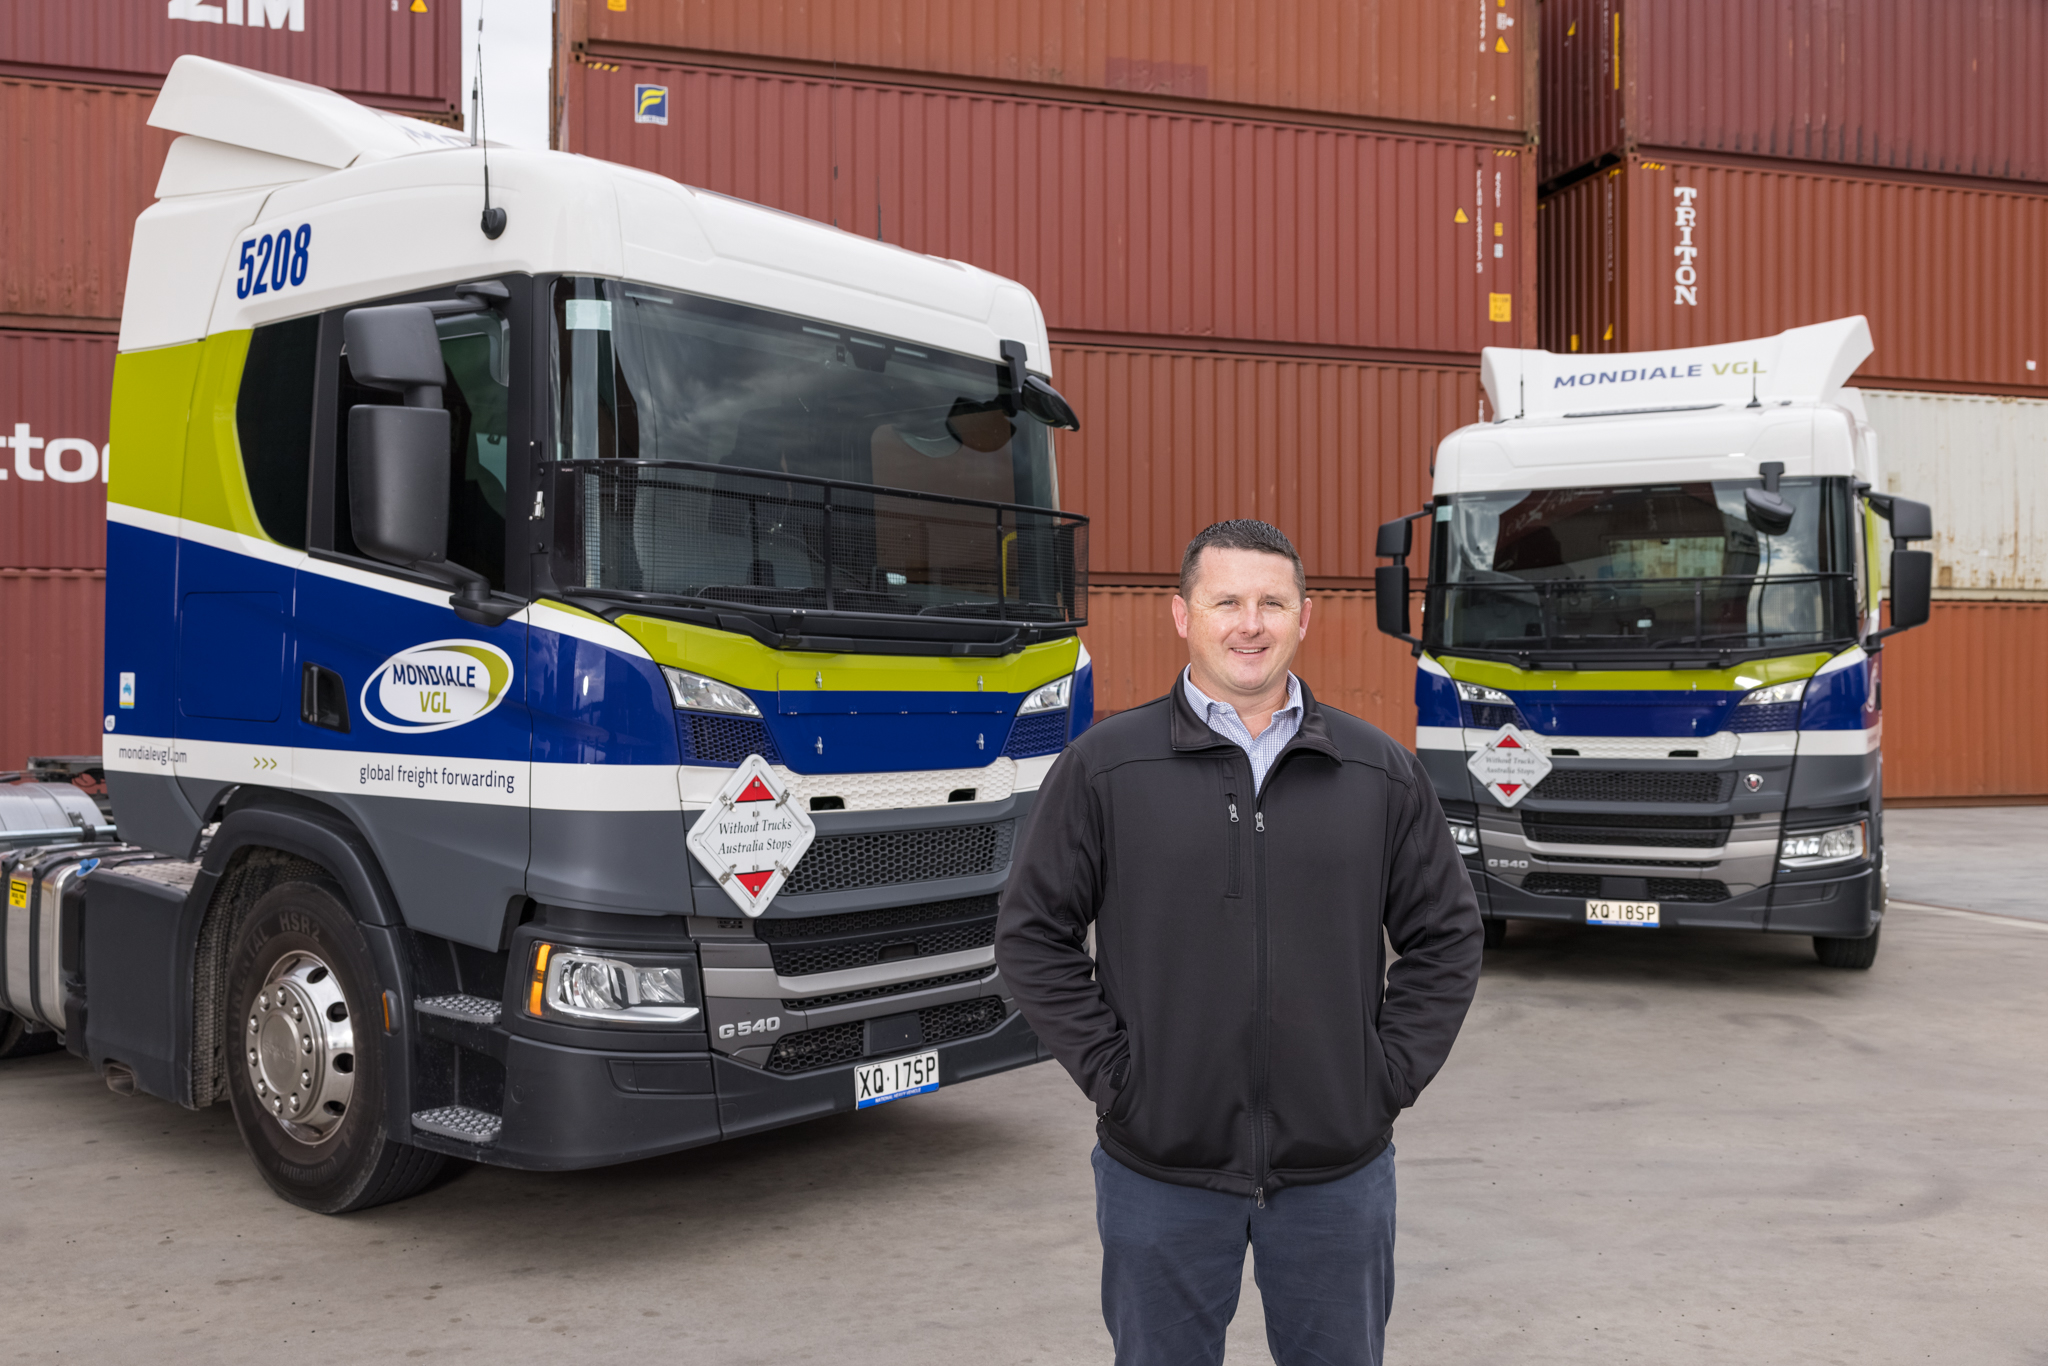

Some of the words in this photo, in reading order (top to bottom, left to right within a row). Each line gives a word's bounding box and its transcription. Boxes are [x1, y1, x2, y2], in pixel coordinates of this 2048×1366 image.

[1674, 186, 1697, 306] TRITON
[236, 223, 311, 300] 5208
[1553, 364, 1702, 389] MONDIALE
[1711, 361, 1767, 376] VGL
[392, 664, 476, 688] MONDIALE
[419, 691, 452, 713] VGL
[359, 763, 394, 784] global
[397, 765, 438, 788] freight
[442, 767, 515, 794] forwarding
[1485, 766, 1515, 774] Australia
[718, 821, 759, 835] Without
[762, 818, 792, 832] Trucks
[717, 839, 764, 855] Australia
[766, 838, 792, 853] Stops
[279, 911, 321, 943] HSR2
